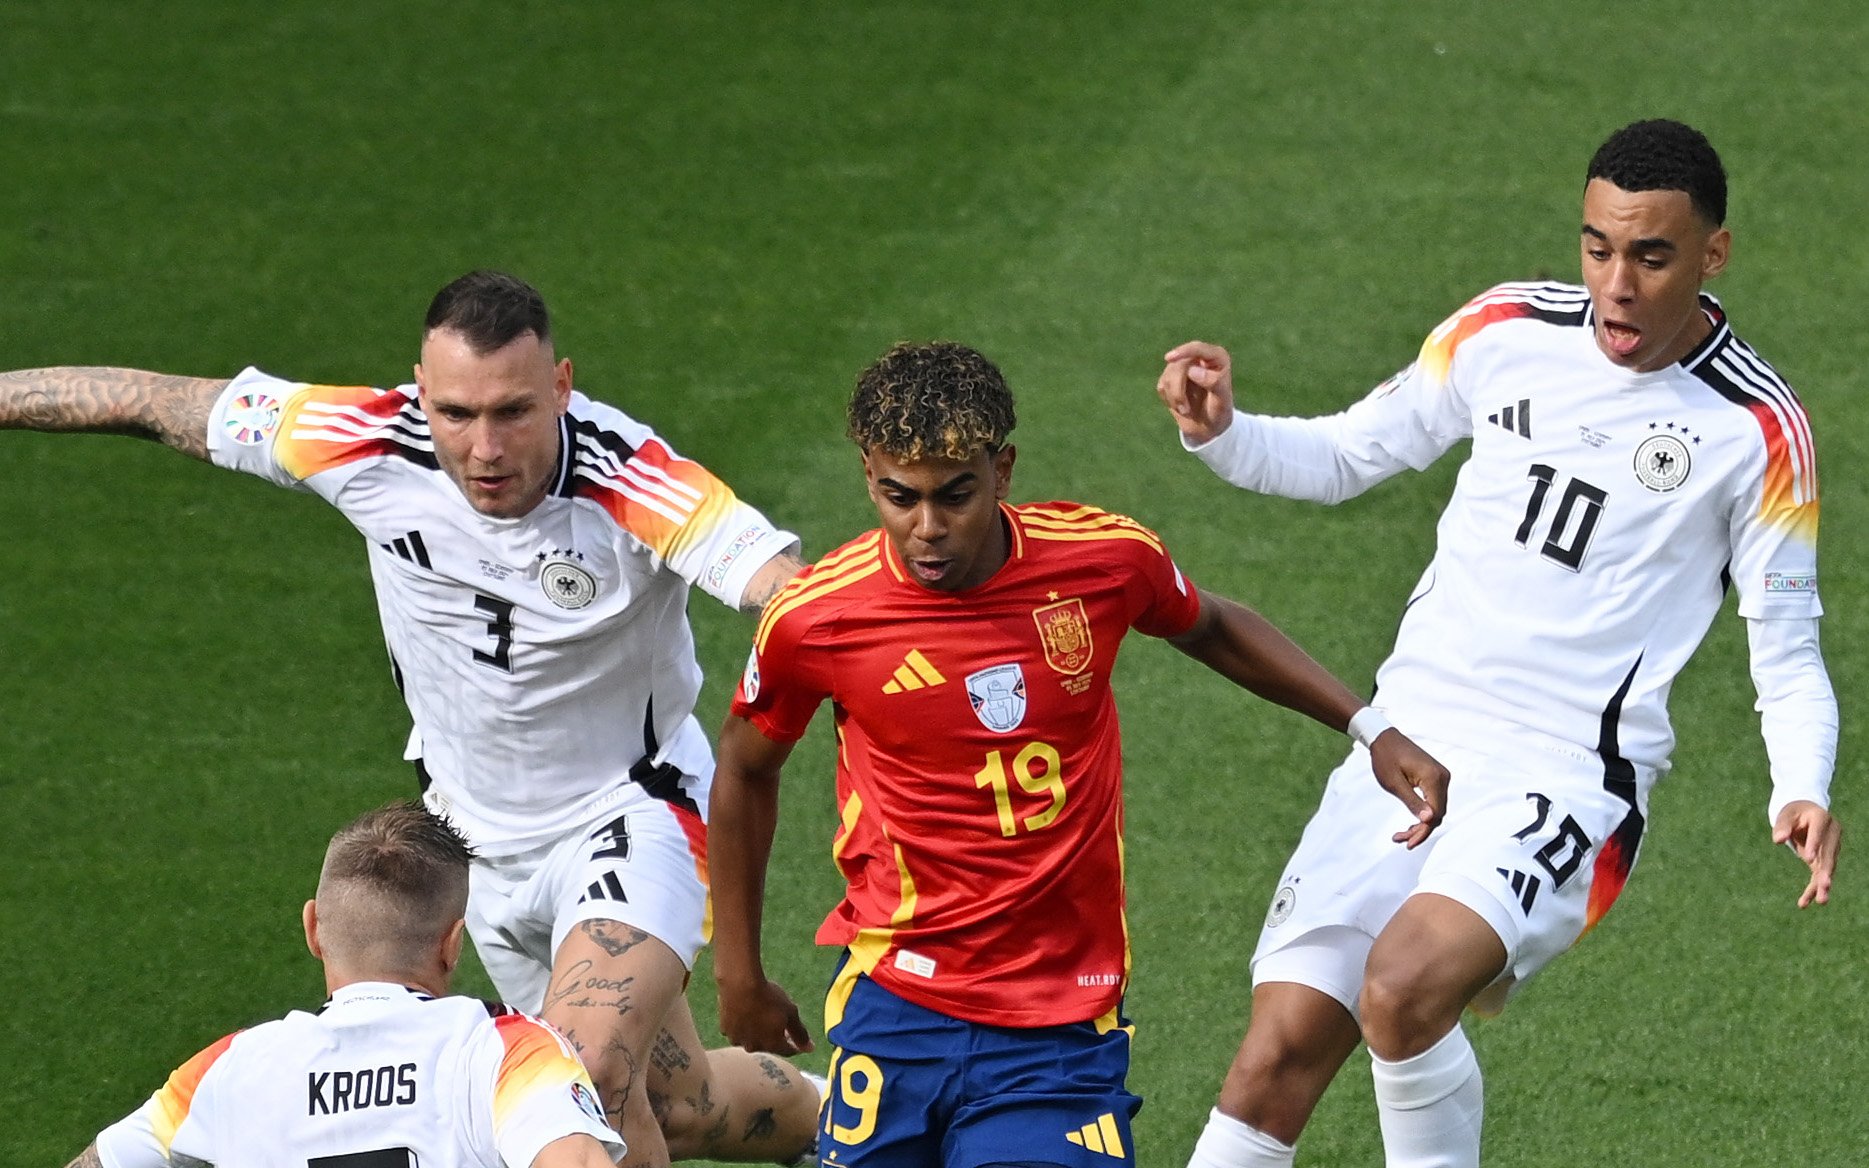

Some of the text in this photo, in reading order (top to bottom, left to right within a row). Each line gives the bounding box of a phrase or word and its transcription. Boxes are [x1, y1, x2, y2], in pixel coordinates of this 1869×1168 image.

[1514, 464, 1610, 574] 10
[711, 526, 760, 588] FOUNDATION
[472, 593, 515, 675] 3
[974, 741, 1067, 837] 19
[589, 814, 633, 863] 3
[1510, 792, 1593, 894] 10
[546, 959, 634, 1008] Good
[1077, 974, 1120, 987] HEAT.RDY
[308, 1062, 417, 1117] KROOS
